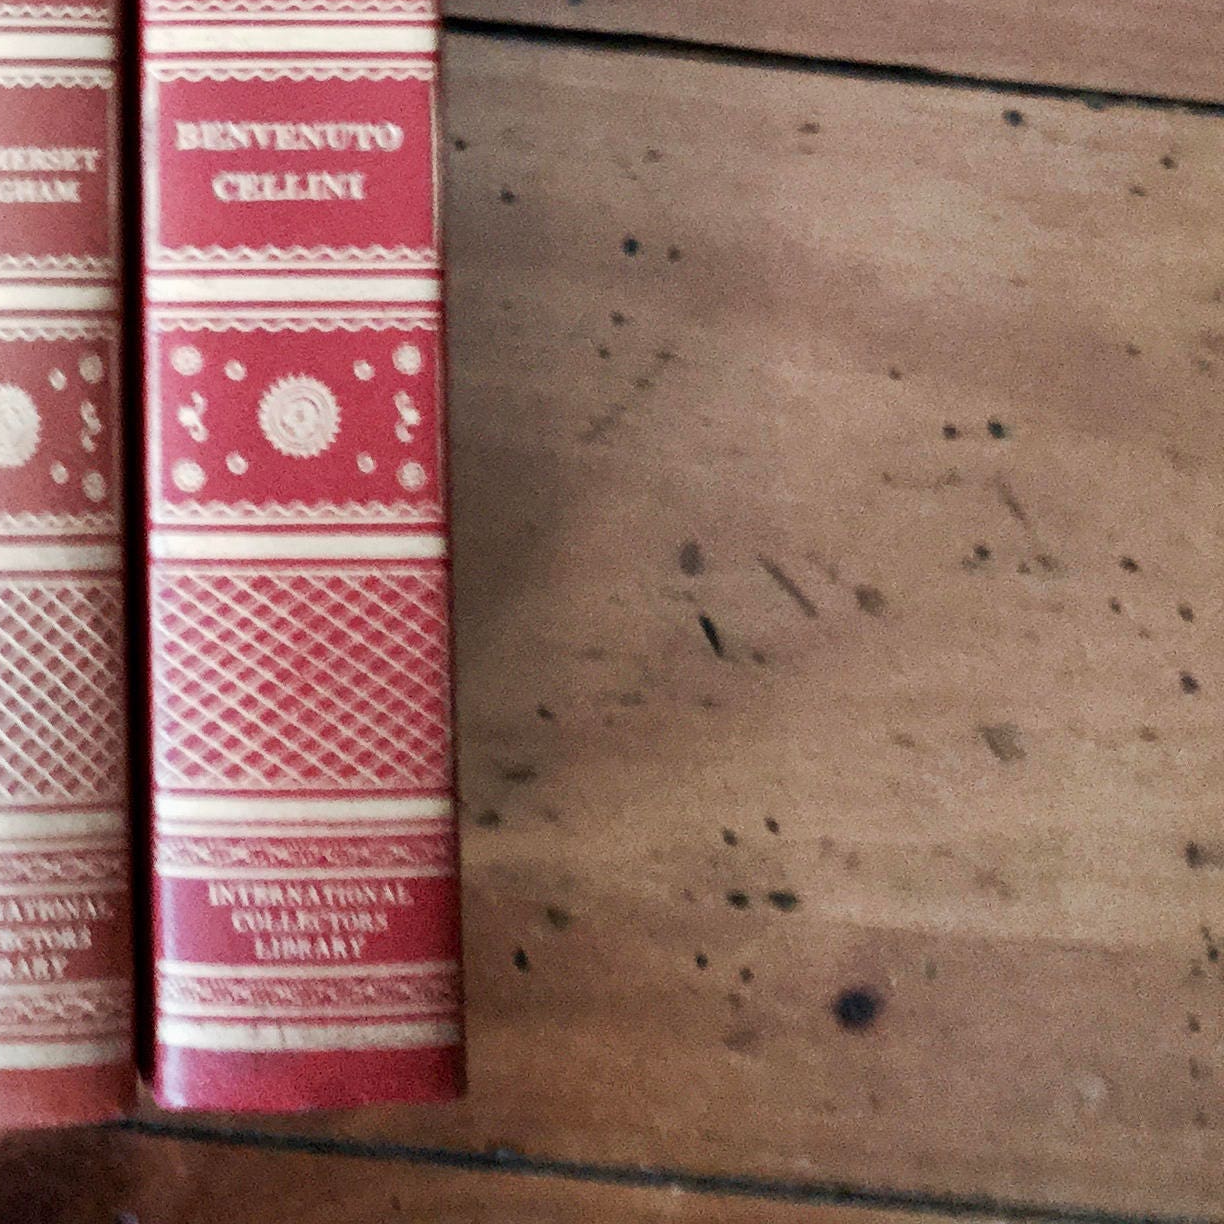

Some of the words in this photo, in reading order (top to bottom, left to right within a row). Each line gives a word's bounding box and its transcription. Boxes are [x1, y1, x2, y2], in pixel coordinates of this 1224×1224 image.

[176, 120, 404, 152] BENVENUTO
[211, 171, 366, 202] CELLINI
[208, 883, 414, 907] INTERNATIONAL
[231, 910, 388, 933] COLLECTORS
[255, 936, 365, 960] LIBRARY
